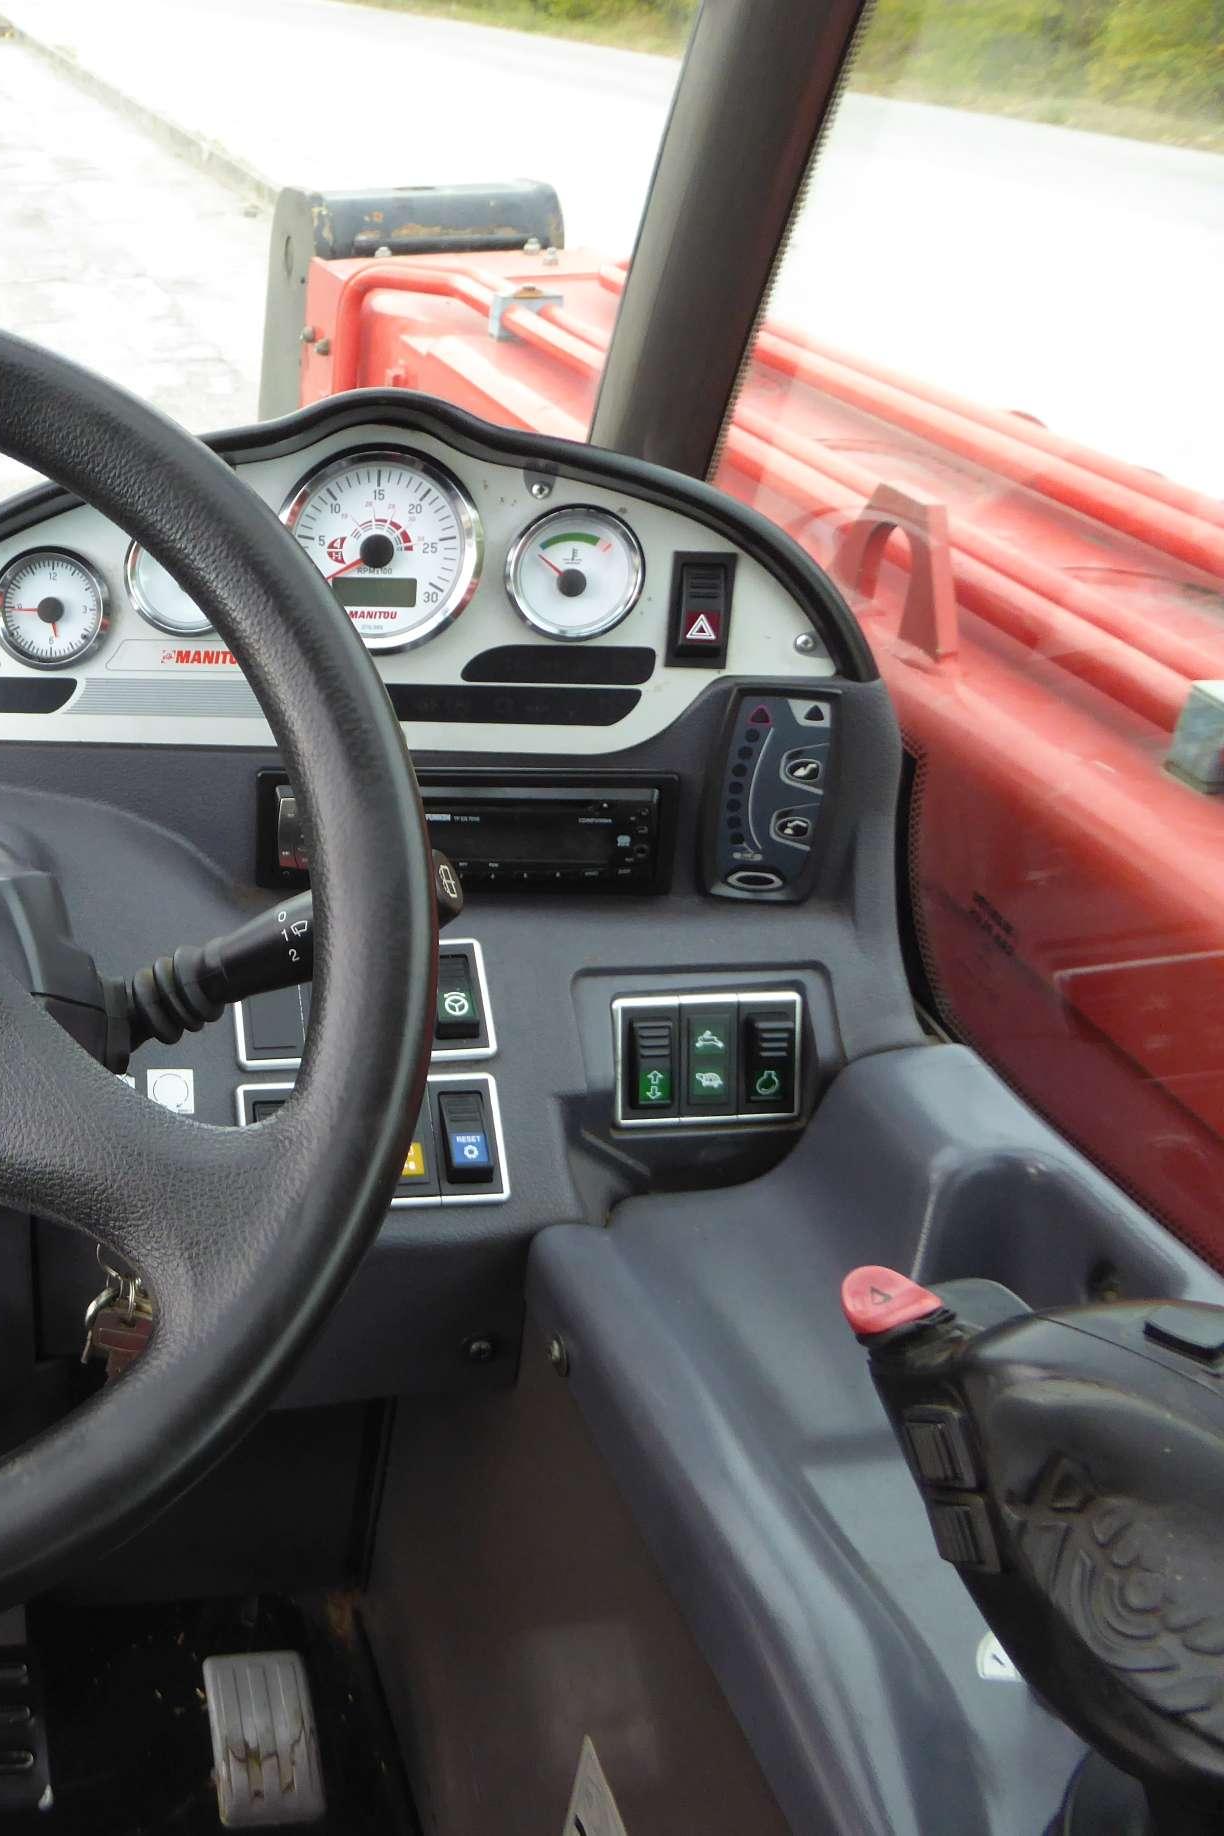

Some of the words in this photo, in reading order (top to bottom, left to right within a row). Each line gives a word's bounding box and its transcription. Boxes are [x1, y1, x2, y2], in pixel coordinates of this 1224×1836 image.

[373, 489, 385, 501] 15
[330, 504, 341, 514] 10
[408, 504, 422, 514] 20
[318, 536, 326, 547] 5
[422, 543, 438, 554] 25
[48, 572, 58, 581] 12
[423, 592, 439, 603] 30
[81, 605, 88, 614] 3
[281, 927, 289, 942] 1
[288, 948, 300, 963] 2
